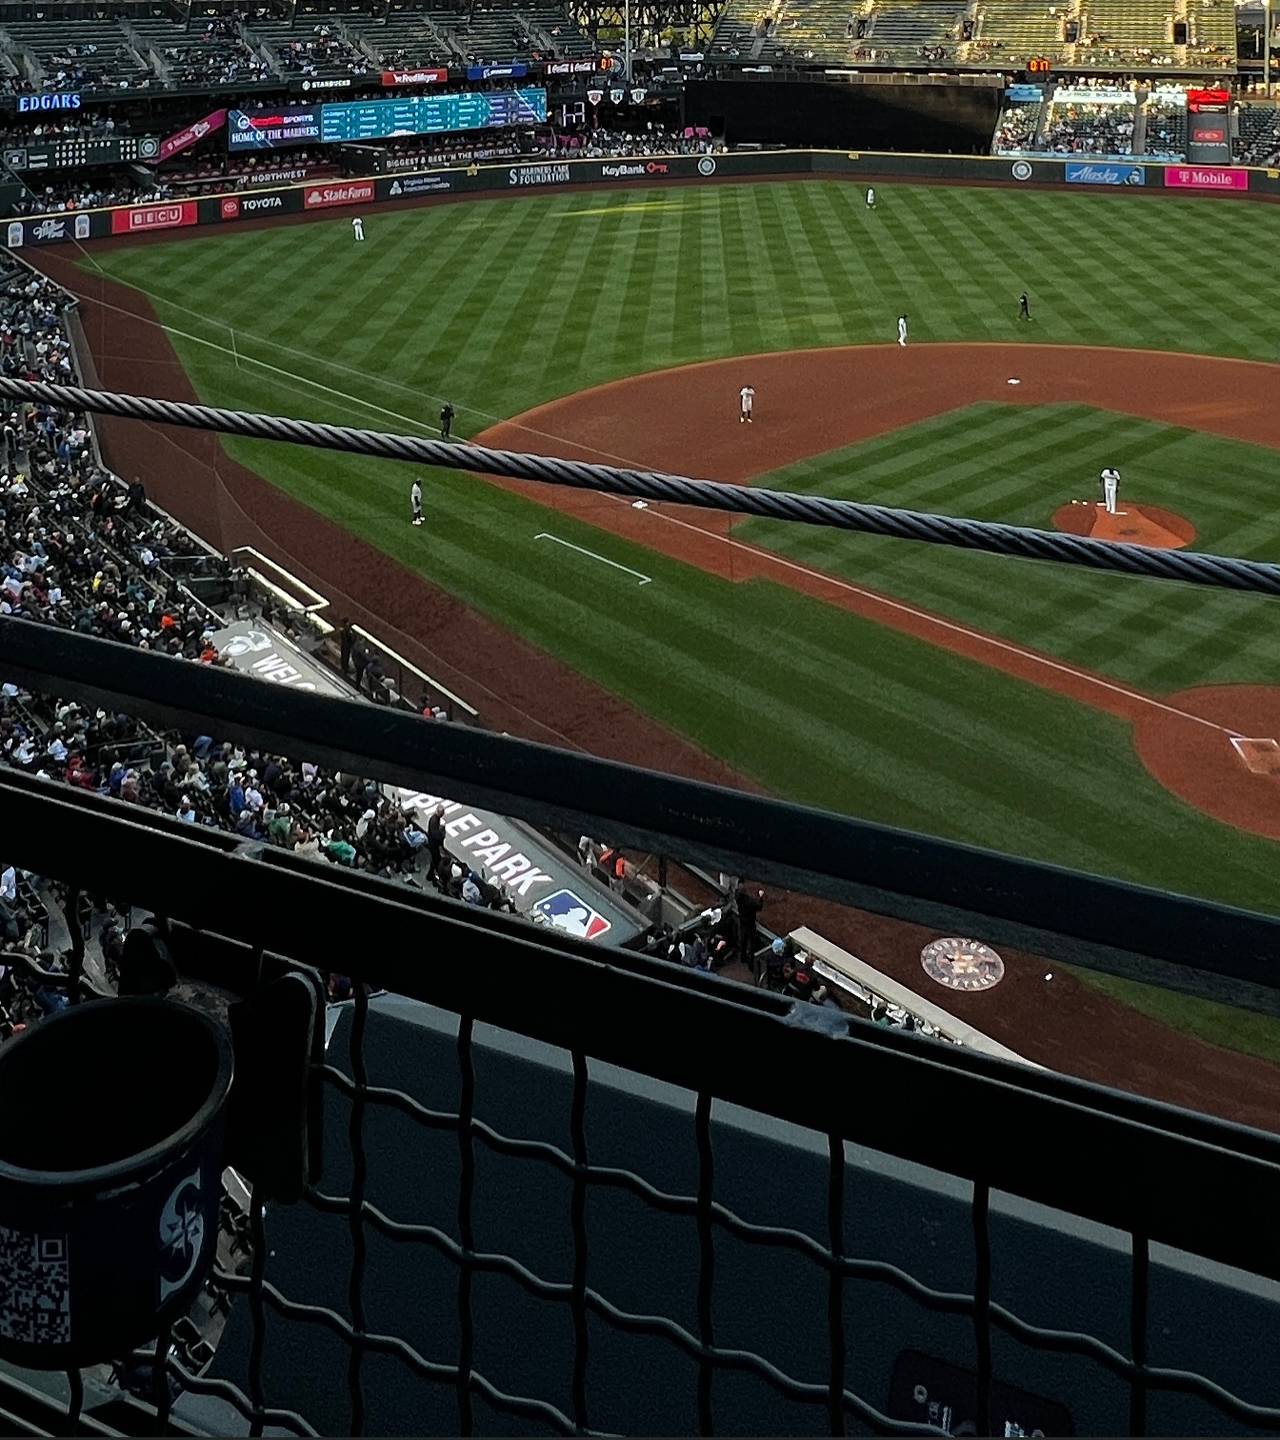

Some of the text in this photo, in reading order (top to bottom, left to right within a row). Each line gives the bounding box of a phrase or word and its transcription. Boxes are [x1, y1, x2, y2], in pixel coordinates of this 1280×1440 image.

[20, 94, 81, 112] EDGARS
[231, 131, 255, 143] HOME
[268, 129, 282, 140] THE
[251, 169, 307, 183] NORTHWEST
[519, 171, 570, 184] FOUNDATION
[602, 164, 645, 177] KeyBank
[1070, 166, 1119, 183] Alaska
[1192, 172, 1232, 185] Mobile
[242, 197, 283, 210] TOYOTA
[460, 829, 554, 897] PARK
